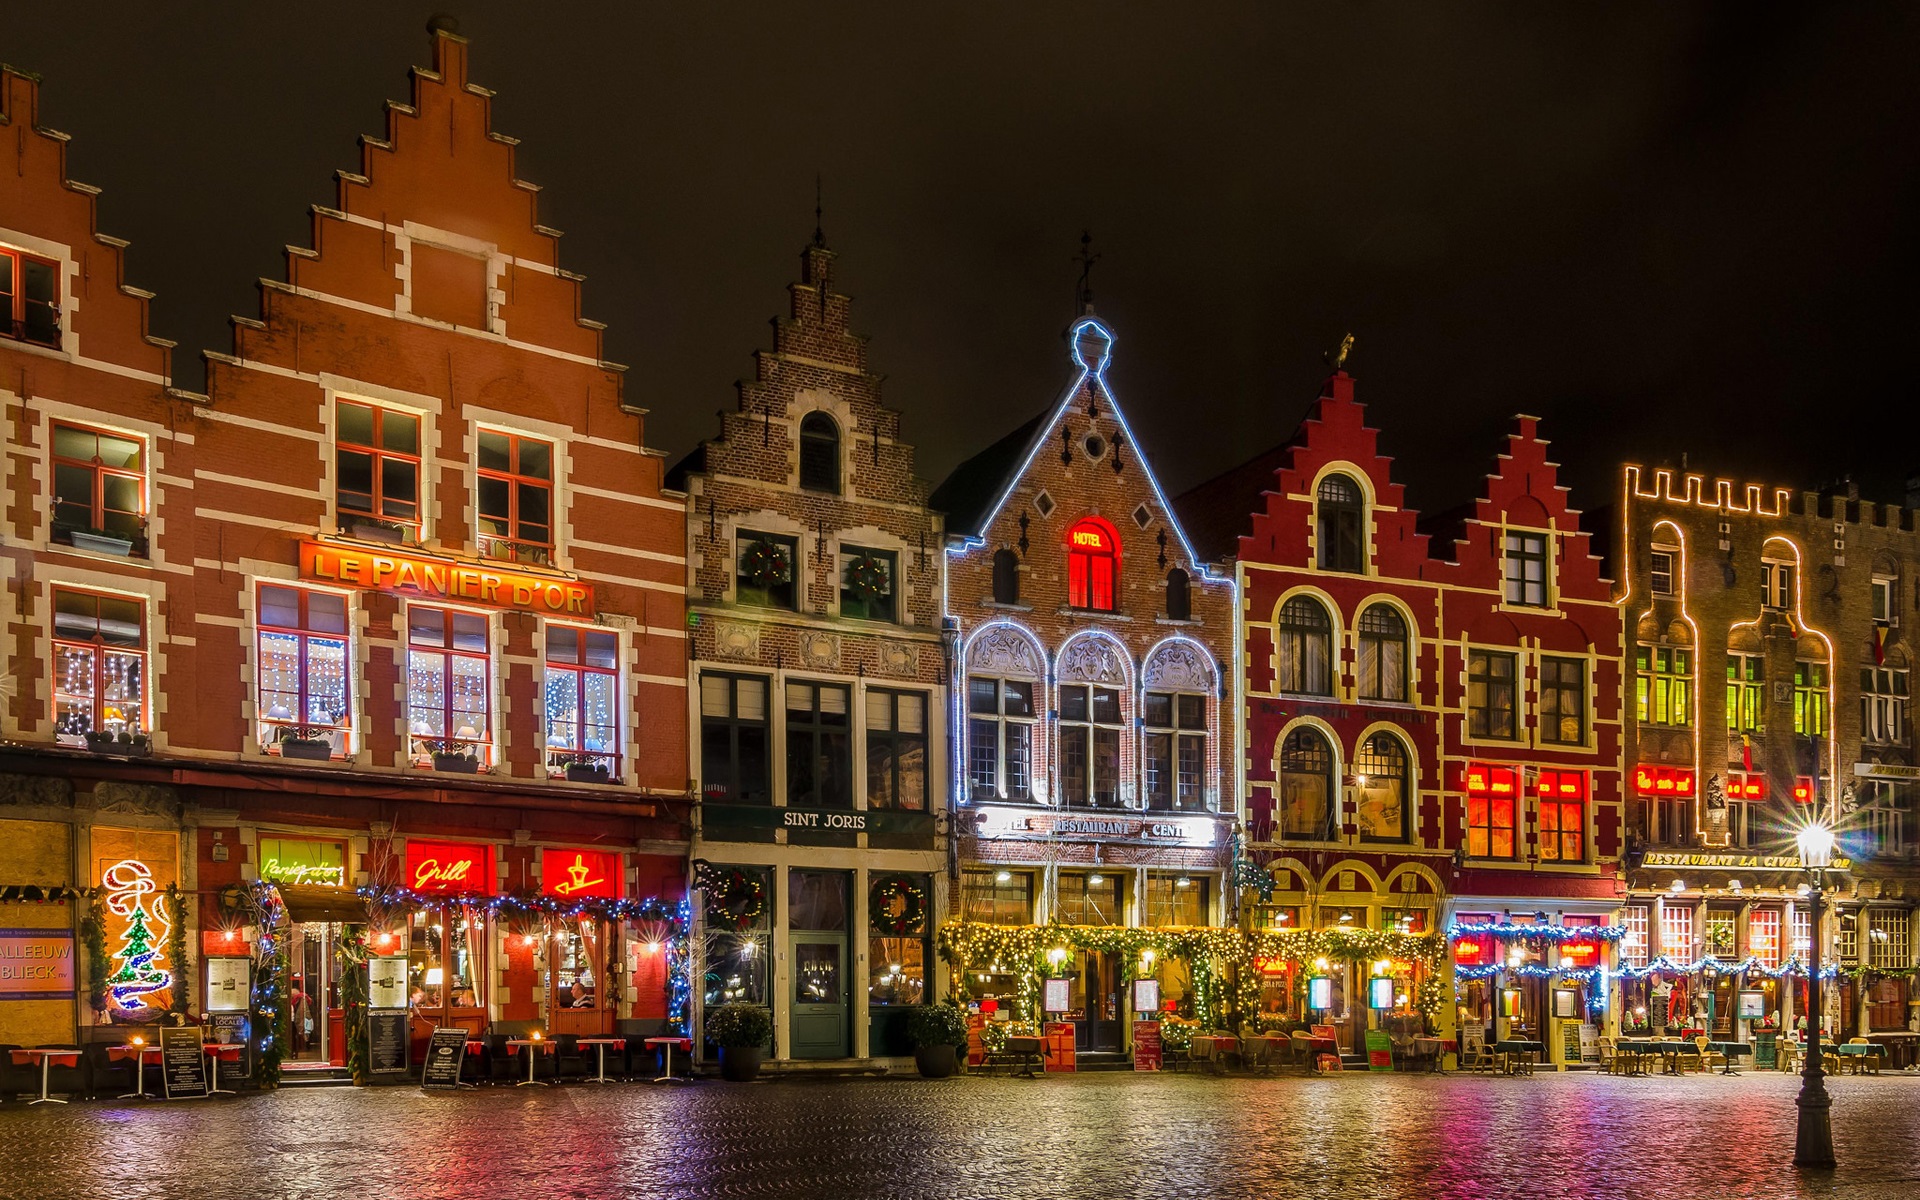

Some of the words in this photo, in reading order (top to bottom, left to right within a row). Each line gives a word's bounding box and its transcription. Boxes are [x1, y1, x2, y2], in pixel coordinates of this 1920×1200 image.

[1073, 531, 1102, 547] HOTEL
[315, 554, 361, 582] LE
[372, 556, 502, 602] PANIER
[512, 581, 588, 614] D'OR
[784, 811, 819, 827] SINT
[823, 814, 866, 830] JORIS
[1053, 819, 1130, 835] RESTAURANT
[262, 858, 307, 877] Panier
[310, 861, 338, 878] d'or
[1646, 853, 1736, 867] RESTAURANT
[1738, 855, 1759, 867] LA
[415, 859, 472, 888] Grill
[1, 965, 57, 980] BLIECK
